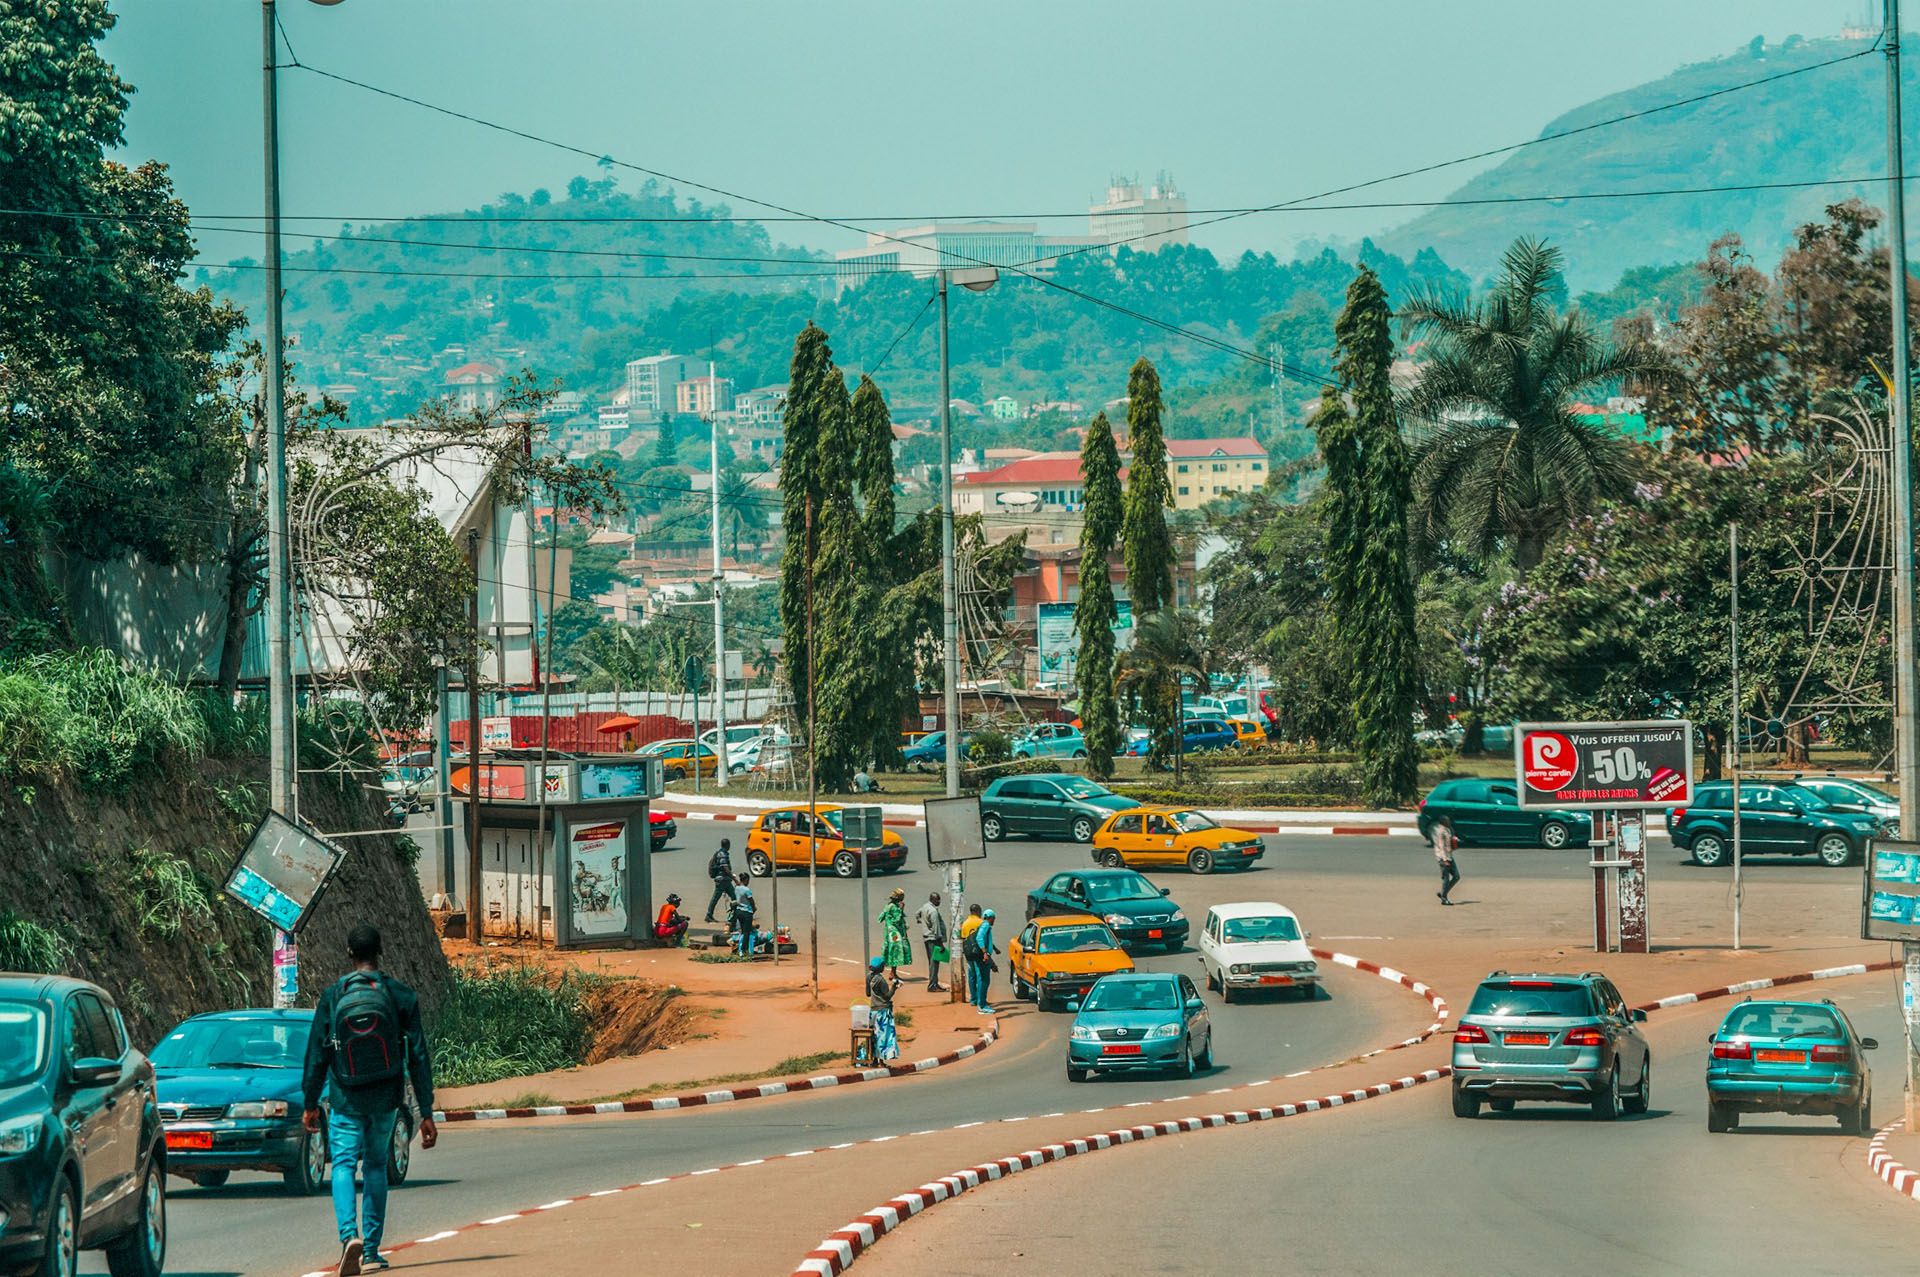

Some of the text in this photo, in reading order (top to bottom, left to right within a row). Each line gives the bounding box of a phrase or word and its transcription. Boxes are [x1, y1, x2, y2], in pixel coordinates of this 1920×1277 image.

[1601, 735, 1640, 745] OFFRENT
[1643, 730, 1682, 743] JUSQU'À
[1525, 769, 1572, 779] pierre cardin
[1557, 788, 1639, 800] DANS TOUS LES RAYONS
